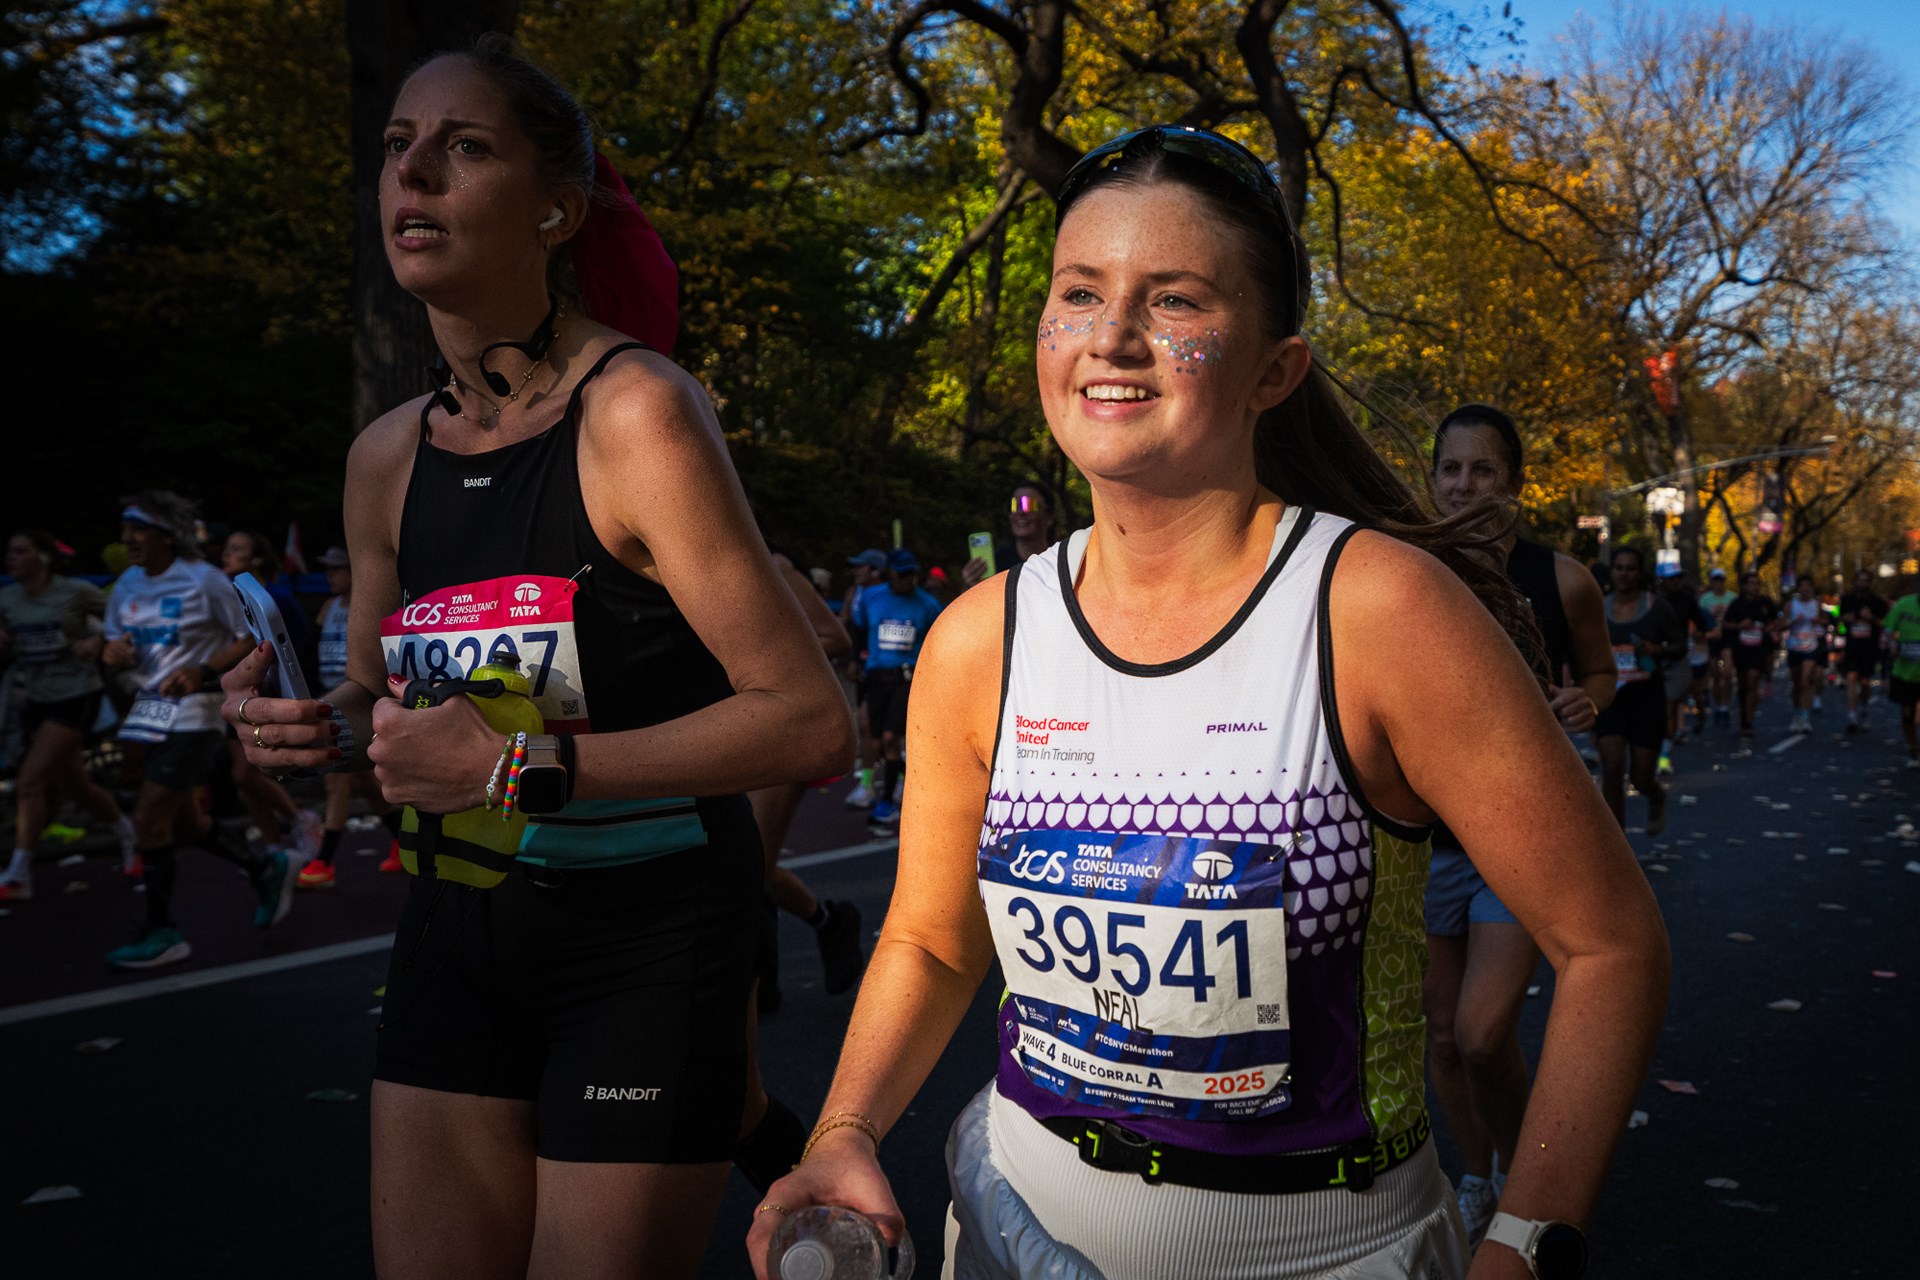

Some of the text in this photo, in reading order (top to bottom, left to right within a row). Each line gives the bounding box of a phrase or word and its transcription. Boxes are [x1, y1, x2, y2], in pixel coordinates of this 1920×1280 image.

[463, 477, 492, 488] BANDIT
[451, 594, 473, 604] TATA
[447, 600, 499, 615] CONSULTANCY
[509, 605, 541, 618] TATA
[443, 614, 480, 625] SERVICES
[1048, 718, 1090, 731] Cancer
[1206, 721, 1268, 734] PRIMAL
[1016, 746, 1095, 765] eam In Training
[1077, 844, 1113, 859] TATA
[1072, 858, 1162, 879] CONSULTANCY
[1071, 876, 1128, 891] SERVICES
[1185, 882, 1238, 900] TATA
[1007, 896, 1252, 1003] 39541
[1091, 987, 1154, 1035] NEAL
[1094, 1033, 1174, 1058] #TCSNYCMarathon
[1022, 1031, 1046, 1053] WAVE
[1046, 1042, 1057, 1061] 4
[1061, 1053, 1087, 1073] BLUE
[1089, 1064, 1143, 1084] CORRAL
[1146, 1072, 1163, 1090] A
[1203, 1071, 1266, 1096] 2025
[596, 1087, 662, 1101] BANDIT
[1091, 1088, 1113, 1099] FERRY
